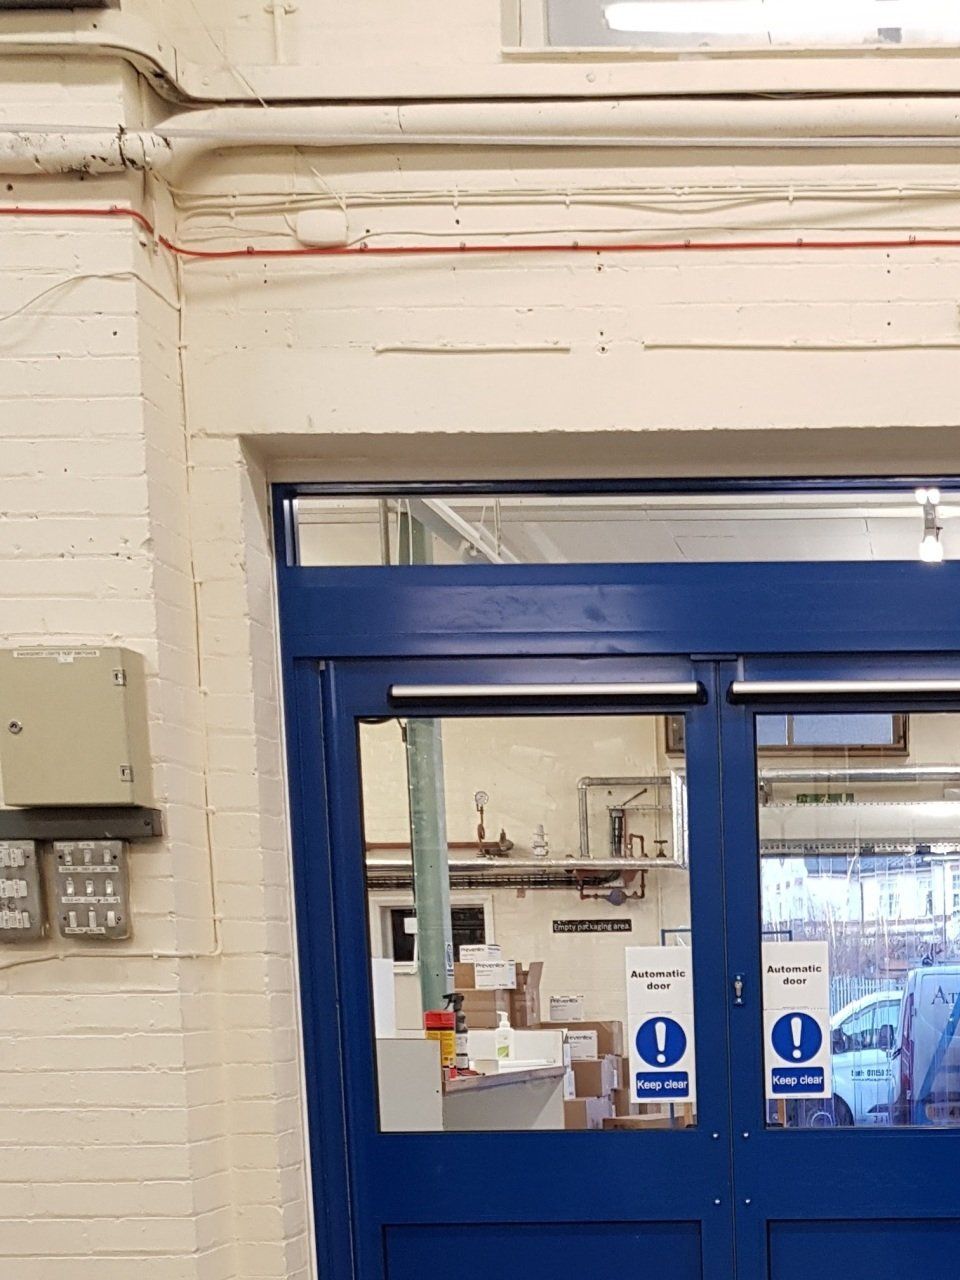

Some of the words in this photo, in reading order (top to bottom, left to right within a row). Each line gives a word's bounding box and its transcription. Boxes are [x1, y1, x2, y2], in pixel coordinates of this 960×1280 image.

[553, 923, 576, 932] Empty
[577, 922, 612, 931] packaging
[631, 969, 686, 979] Automatic
[767, 965, 822, 974] Automatic
[646, 982, 671, 990] door
[782, 977, 808, 985] door
[637, 1080, 662, 1091] Keep
[664, 1079, 688, 1089] clear
[773, 1075, 798, 1086] Keep
[800, 1074, 824, 1085] clear
